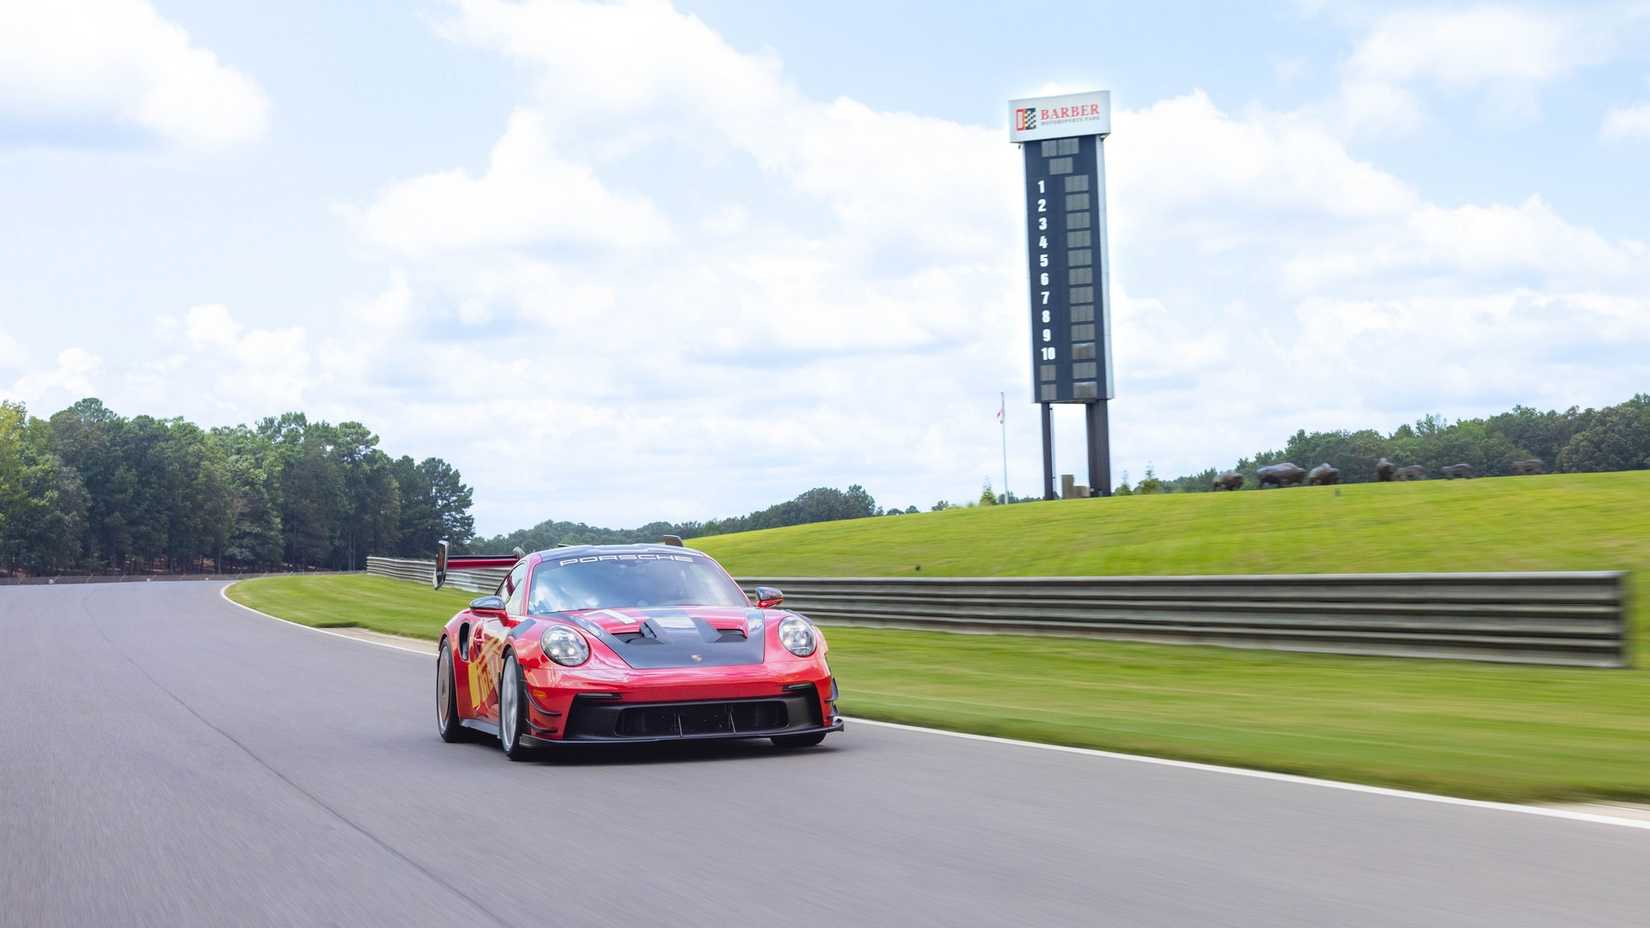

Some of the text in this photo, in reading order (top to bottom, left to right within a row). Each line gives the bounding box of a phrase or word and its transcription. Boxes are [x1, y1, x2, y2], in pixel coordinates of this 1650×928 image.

[1041, 104, 1099, 120] BARBER
[1038, 180, 1045, 193] 1
[1037, 199, 1046, 212] 2
[1038, 217, 1047, 230] 3
[1038, 235, 1048, 248] 4
[1039, 254, 1048, 267] 5
[1040, 272, 1048, 285] 6
[1041, 291, 1050, 304] 7
[1042, 310, 1050, 323] 8
[1042, 328, 1051, 342] 9
[1041, 347, 1056, 360] 10
[560, 555, 693, 566] PORSCHE
